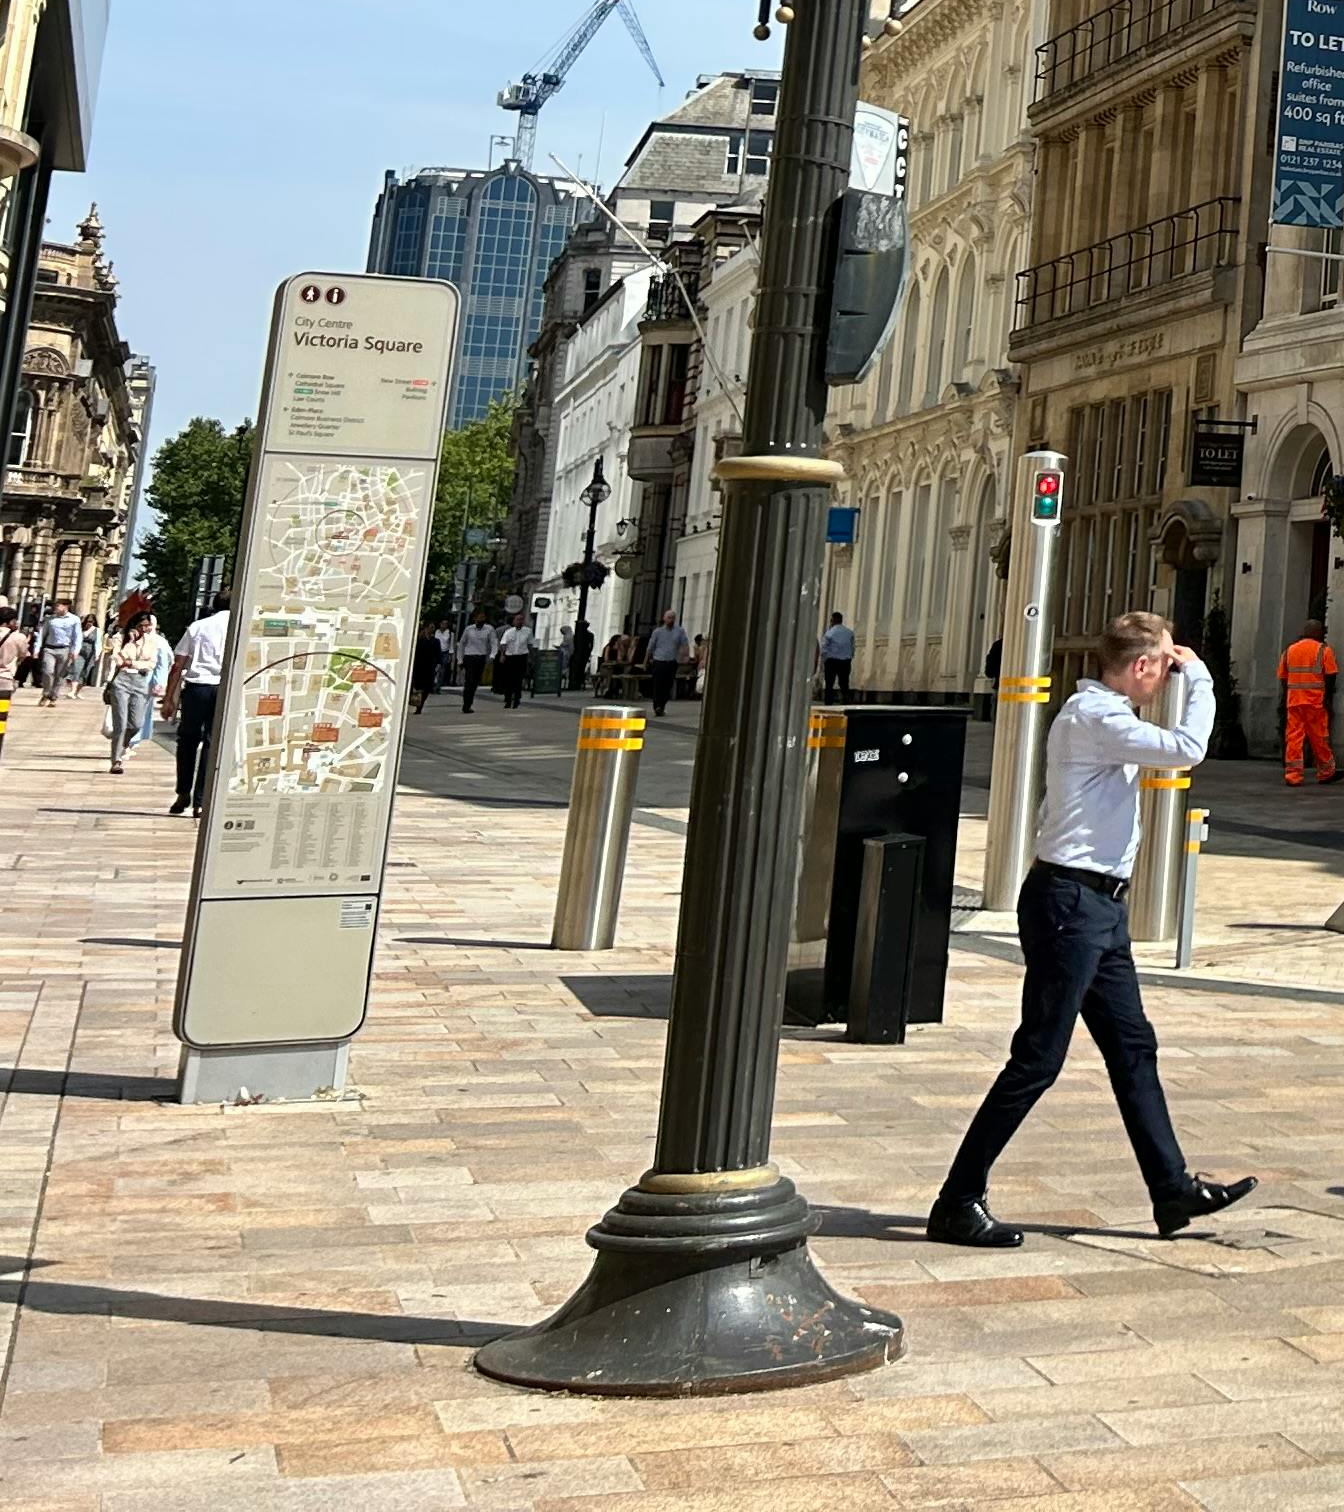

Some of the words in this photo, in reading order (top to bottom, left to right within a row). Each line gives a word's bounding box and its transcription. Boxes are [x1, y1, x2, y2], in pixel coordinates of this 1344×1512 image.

[1307, 0, 1337, 15] Row
[1290, 30, 1315, 47] TO
[1302, 78, 1332, 91] office
[1286, 92, 1317, 104] suites
[1319, 94, 1344, 107] from
[1284, 105, 1312, 121] 400
[1315, 112, 1331, 126] sq
[1280, 154, 1300, 164] 0121
[295, 316, 315, 328] City
[318, 318, 353, 329] Centre
[294, 331, 358, 349] Victoria
[364, 336, 423, 354] Square
[1200, 448, 1216, 458] TO
[1217, 448, 1239, 460] LET
